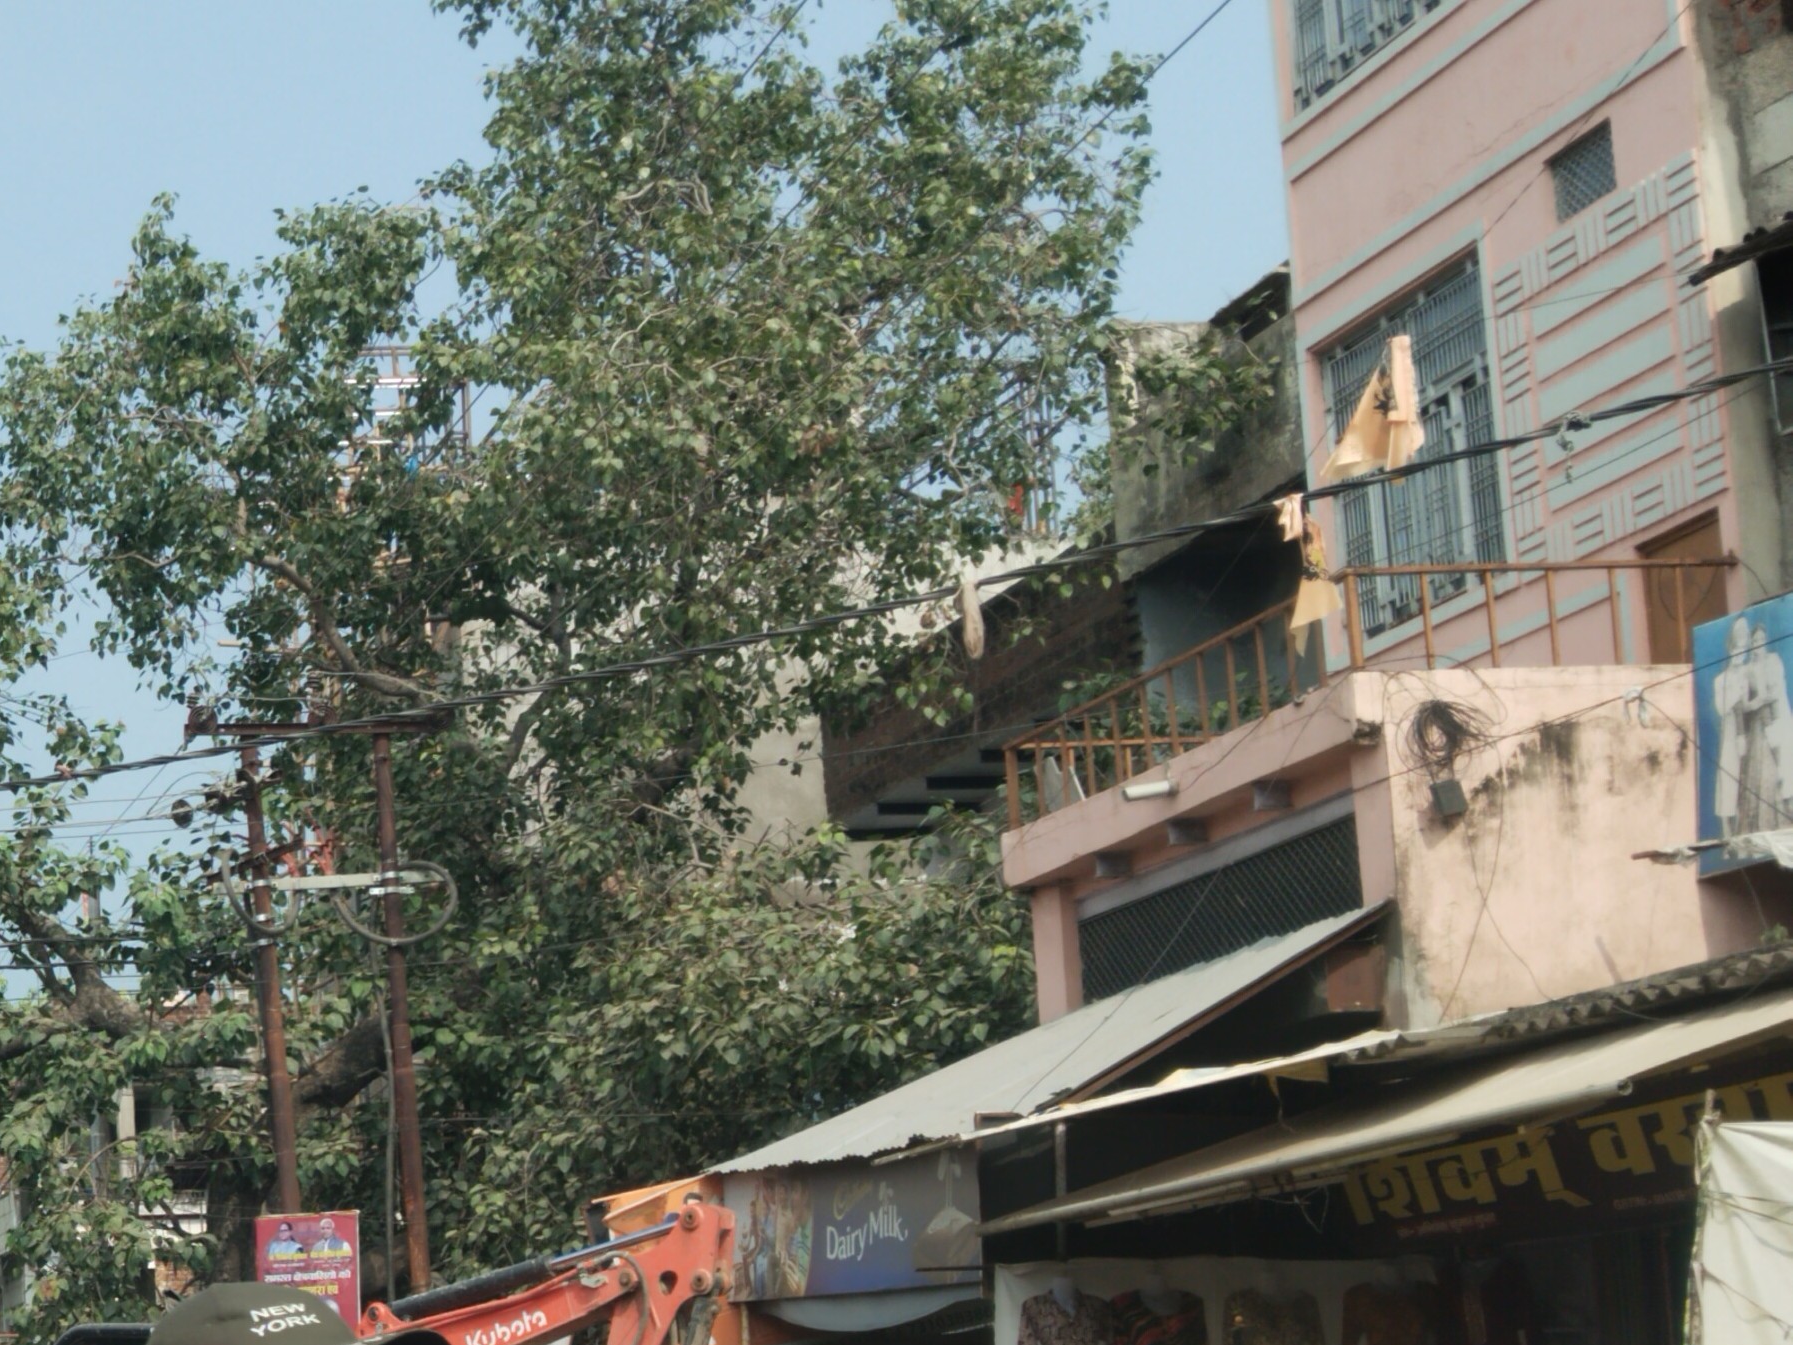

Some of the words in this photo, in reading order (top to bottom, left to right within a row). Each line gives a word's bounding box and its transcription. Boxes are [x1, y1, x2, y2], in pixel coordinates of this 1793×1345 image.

[826, 1219, 868, 1261] Dairy
[869, 1204, 908, 1245] Milk
[250, 1303, 305, 1322] NEW
[250, 1313, 321, 1337] YORK
